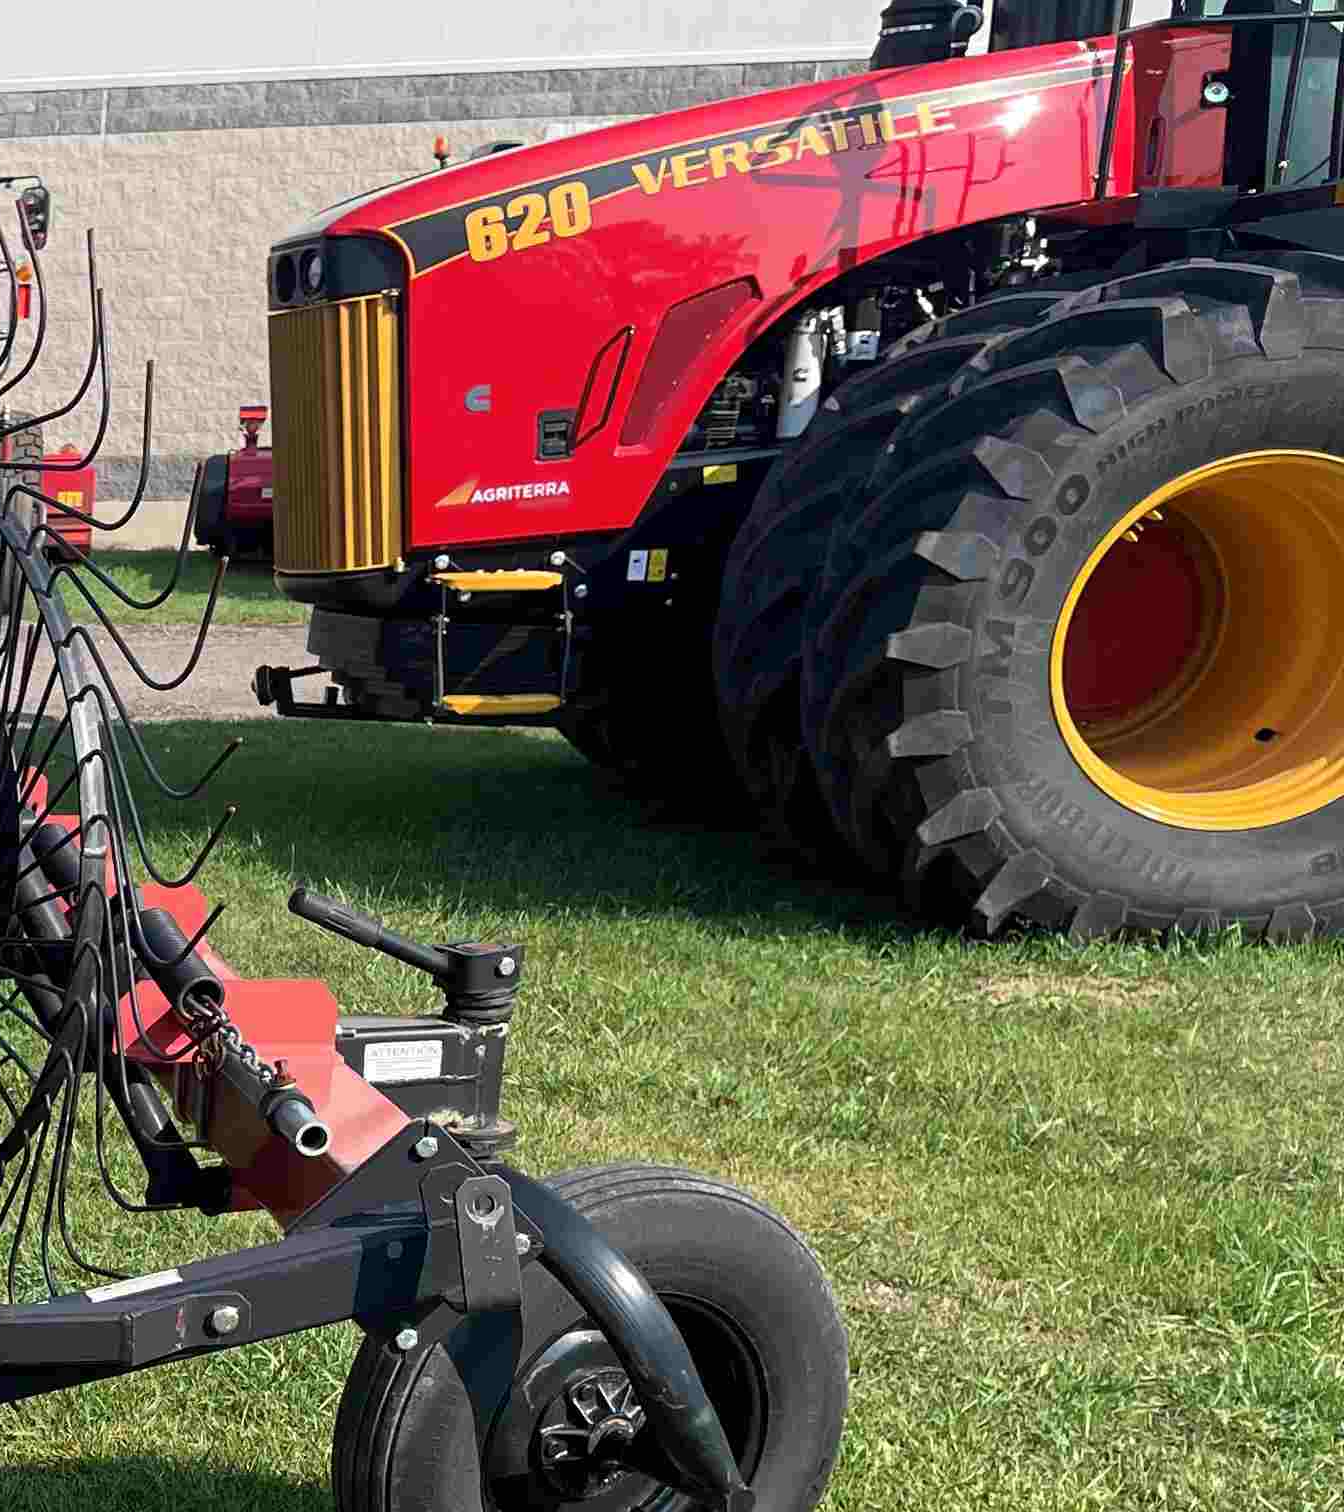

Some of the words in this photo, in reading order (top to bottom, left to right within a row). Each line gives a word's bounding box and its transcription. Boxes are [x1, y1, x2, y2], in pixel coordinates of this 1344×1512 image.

[631, 103, 956, 195] VERSATILE
[465, 181, 592, 262] 620
[470, 480, 571, 504] AGRITERRA
